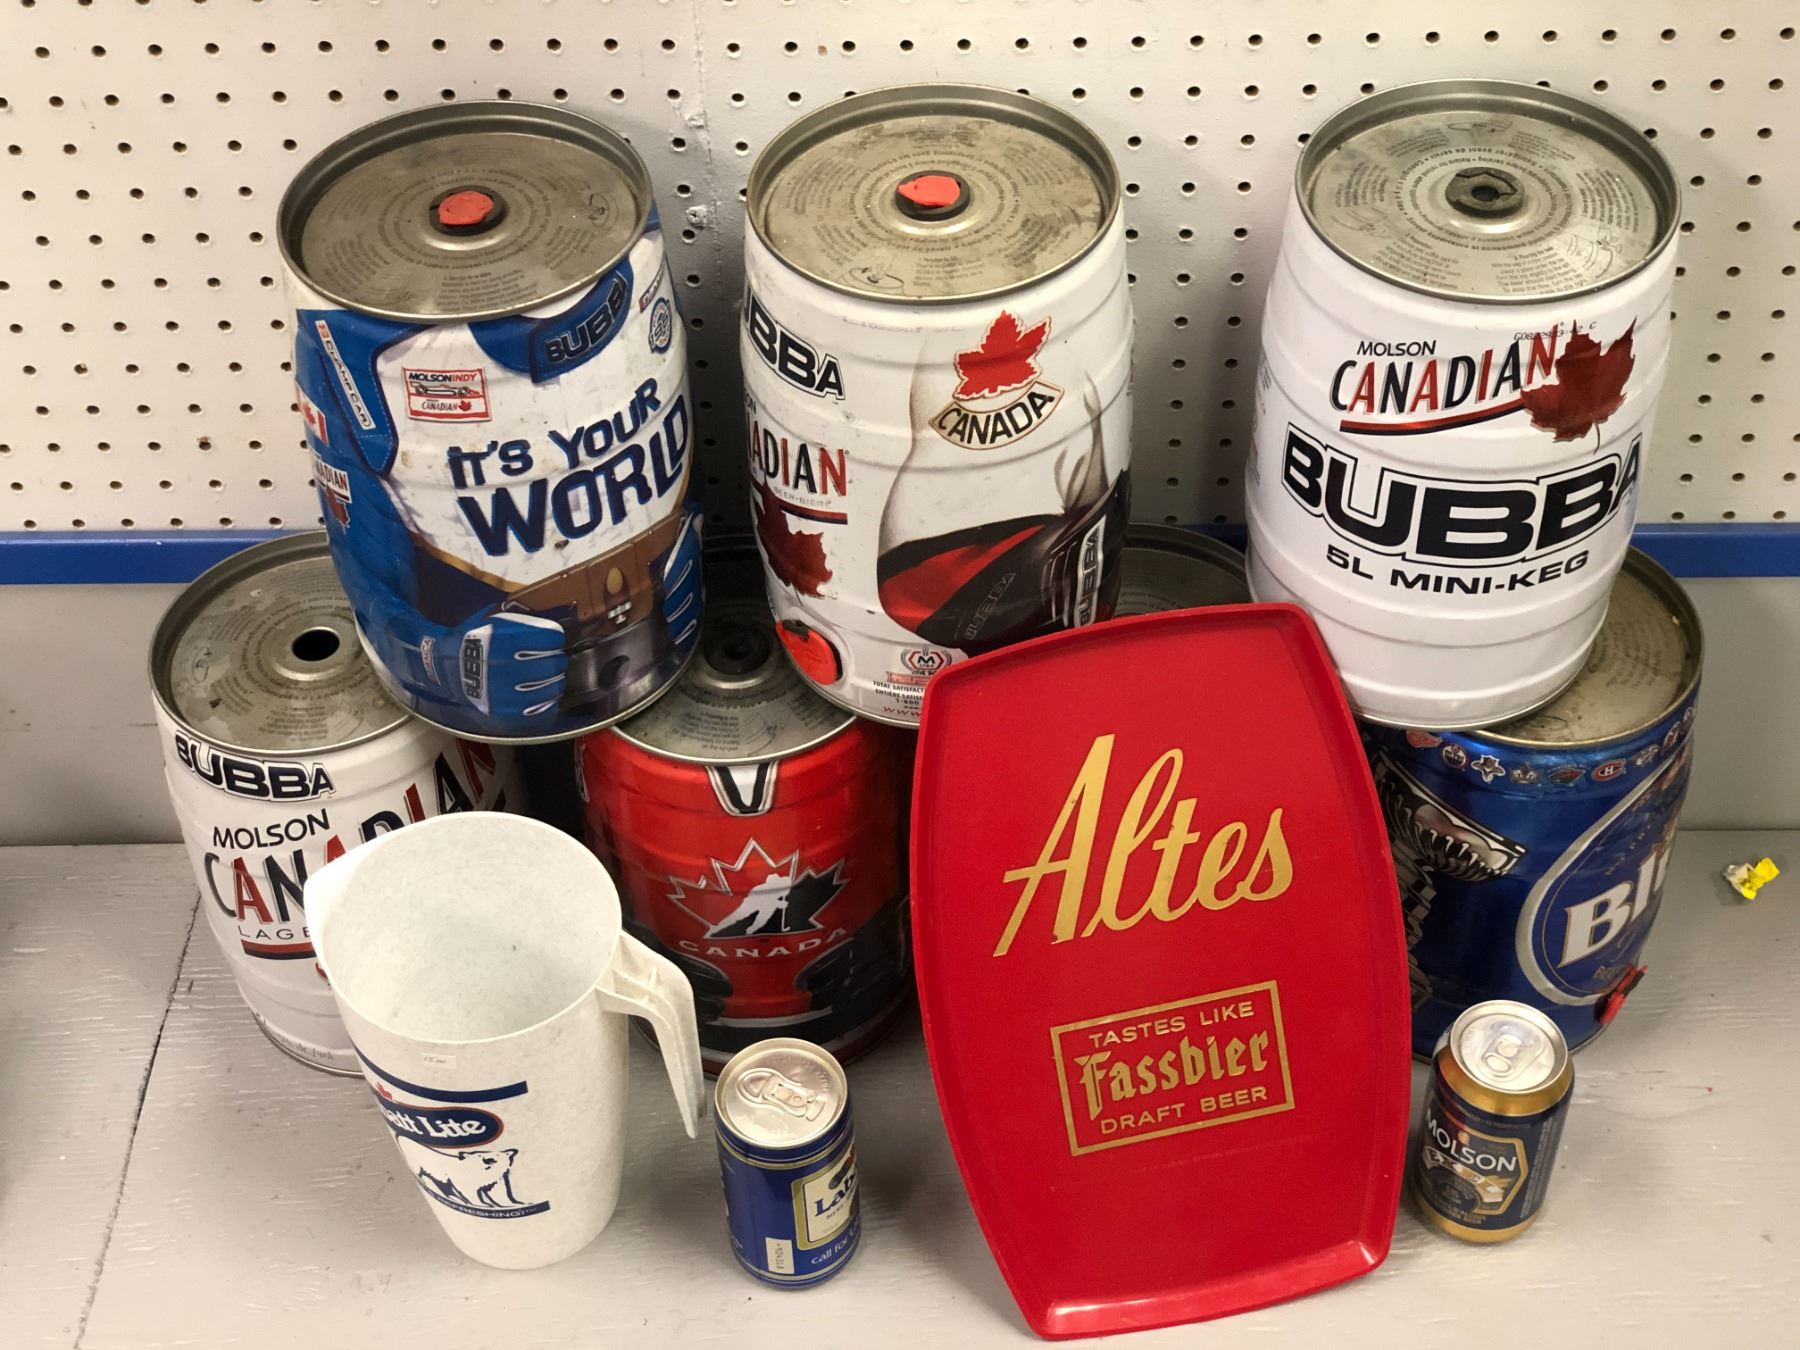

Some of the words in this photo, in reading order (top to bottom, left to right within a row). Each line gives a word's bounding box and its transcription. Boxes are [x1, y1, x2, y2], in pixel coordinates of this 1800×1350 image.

[1329, 323, 1560, 416] CANADIAN
[1356, 340, 1437, 357] MOLSON
[447, 440, 534, 489] IT'S
[548, 377, 660, 468] YOUR
[936, 389, 1056, 446] CANADA
[456, 394, 689, 557] WORLD
[1281, 421, 1644, 569] BUBBA
[1325, 543, 1374, 580] 5L
[1390, 549, 1590, 595] MINI-KEG
[892, 684, 925, 694] SATISFACT
[174, 730, 337, 802] BUBBA
[213, 807, 331, 850] MOLSON
[992, 733, 1294, 957] Altes
[237, 924, 311, 941] LAGE
[678, 927, 848, 958] CANADA
[1088, 1016, 1187, 1049] TASTES
[1199, 1000, 1255, 1026] LIKE
[1073, 1028, 1270, 1121] Fassbier
[416, 1115, 487, 1138] Lite
[1100, 1102, 1186, 1135] DRAFT
[1199, 1085, 1269, 1113] BEER
[1425, 1107, 1518, 1172] MOLSON
